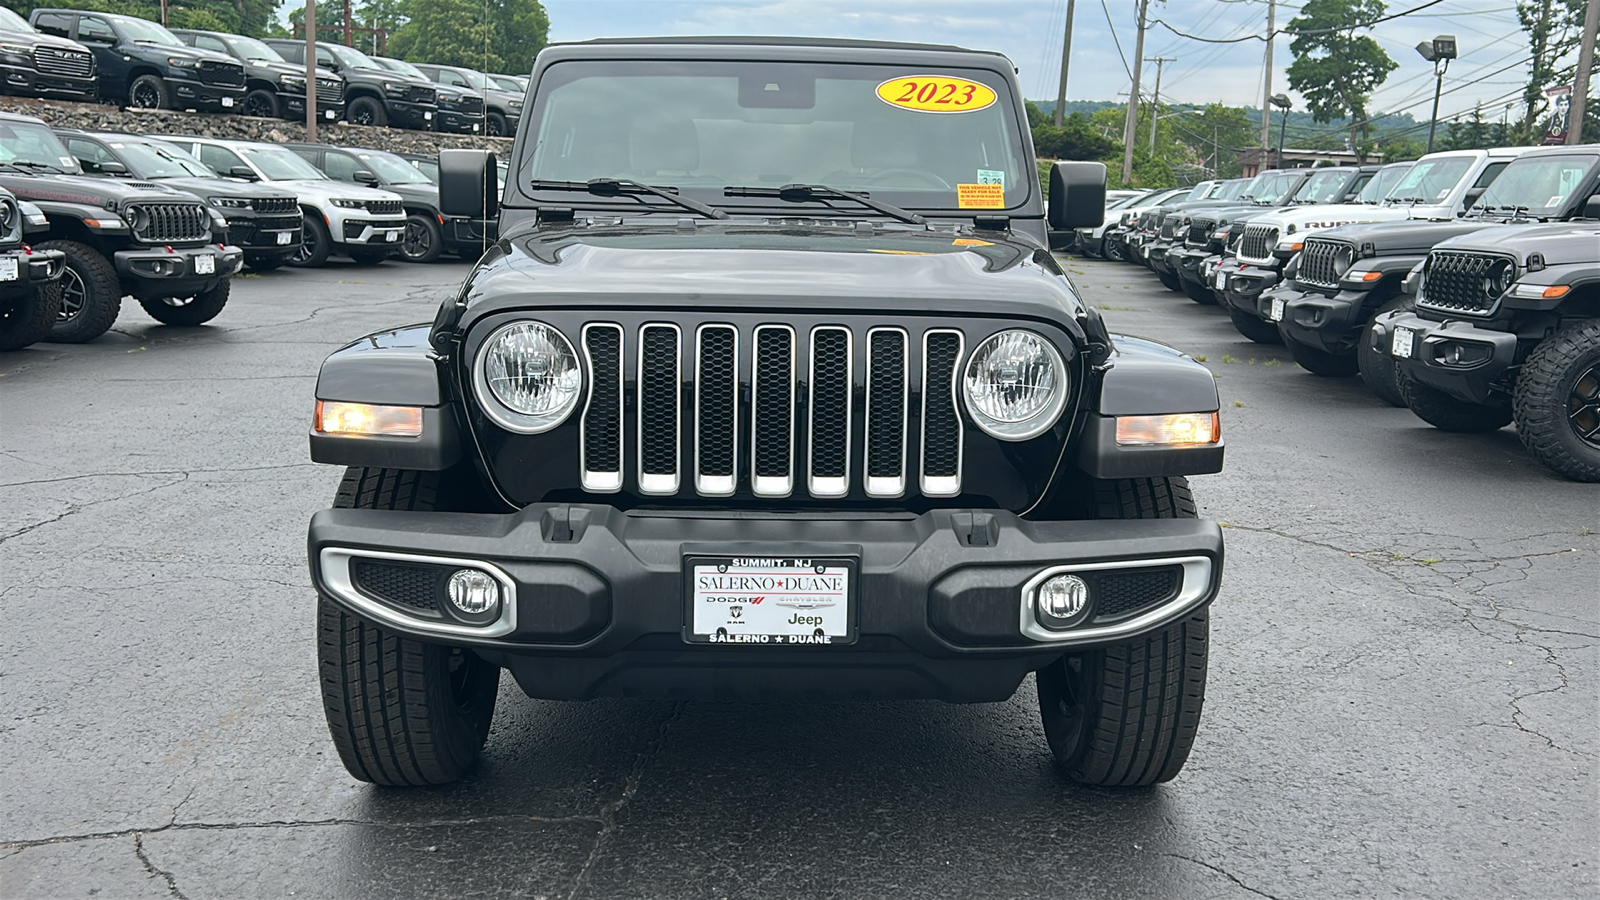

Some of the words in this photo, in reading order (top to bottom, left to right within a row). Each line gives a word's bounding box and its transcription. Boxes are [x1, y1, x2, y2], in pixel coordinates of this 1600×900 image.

[895, 82, 977, 105] 2023
[732, 559, 787, 567] SUMMIT,
[794, 559, 812, 568] NJ
[699, 576, 775, 591] SALERNO
[785, 577, 843, 591] DUANE
[788, 613, 823, 627] Jeep
[709, 634, 769, 643] SALERNO
[789, 635, 832, 644] DUANE
